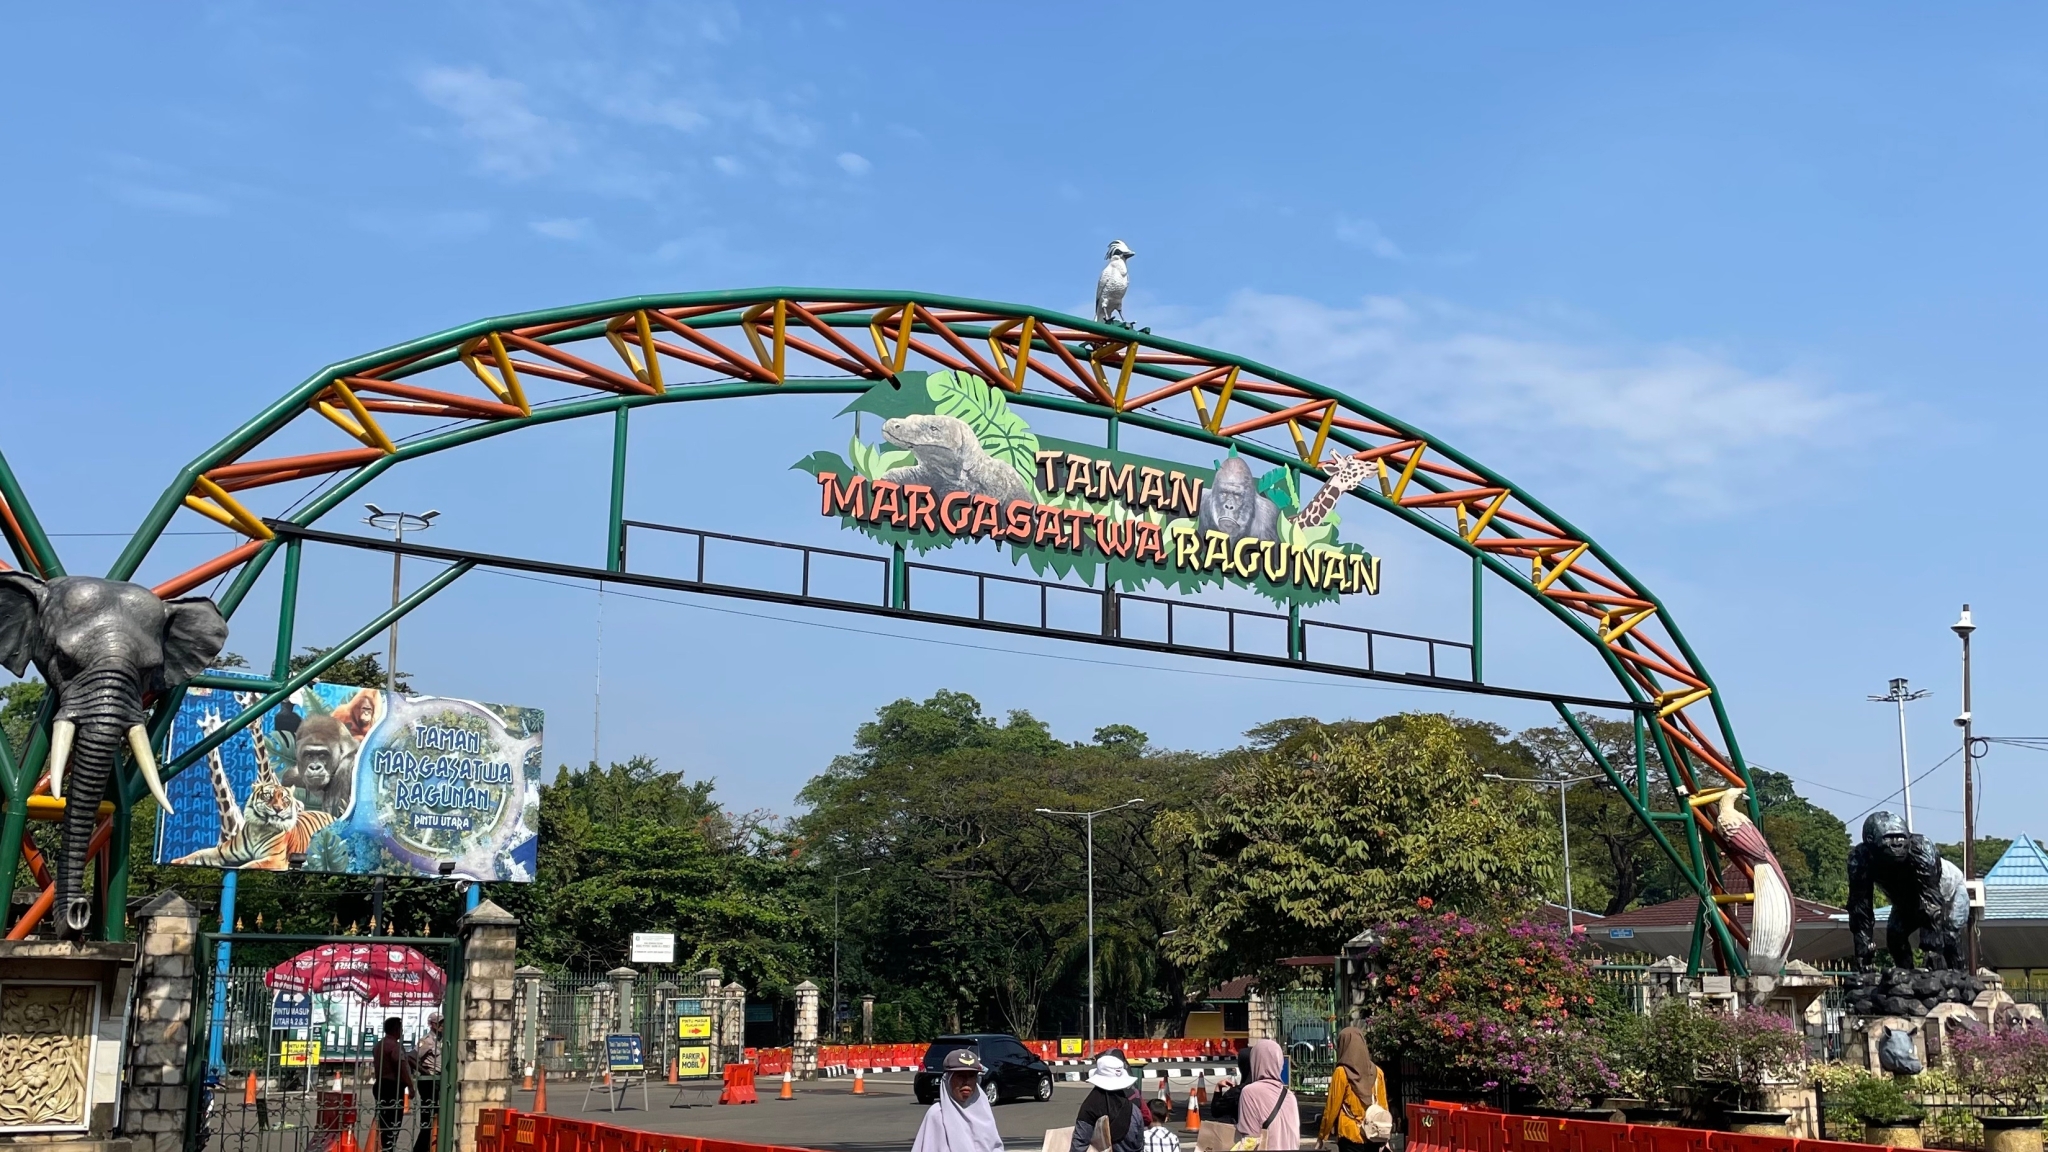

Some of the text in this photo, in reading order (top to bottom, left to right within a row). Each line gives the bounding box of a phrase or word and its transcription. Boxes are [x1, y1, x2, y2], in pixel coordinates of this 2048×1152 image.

[1035, 449, 1205, 518] TAMAN
[817, 471, 1169, 564] MARGASATWA
[1171, 526, 1381, 596] RAGUNAN
[416, 726, 480, 753] TAMAN
[374, 750, 513, 787] MARGASATWA
[395, 780, 490, 810] RAGUNAN
[413, 813, 470, 831] PINTU UTARA
[682, 1061, 700, 1069] MOBIL
